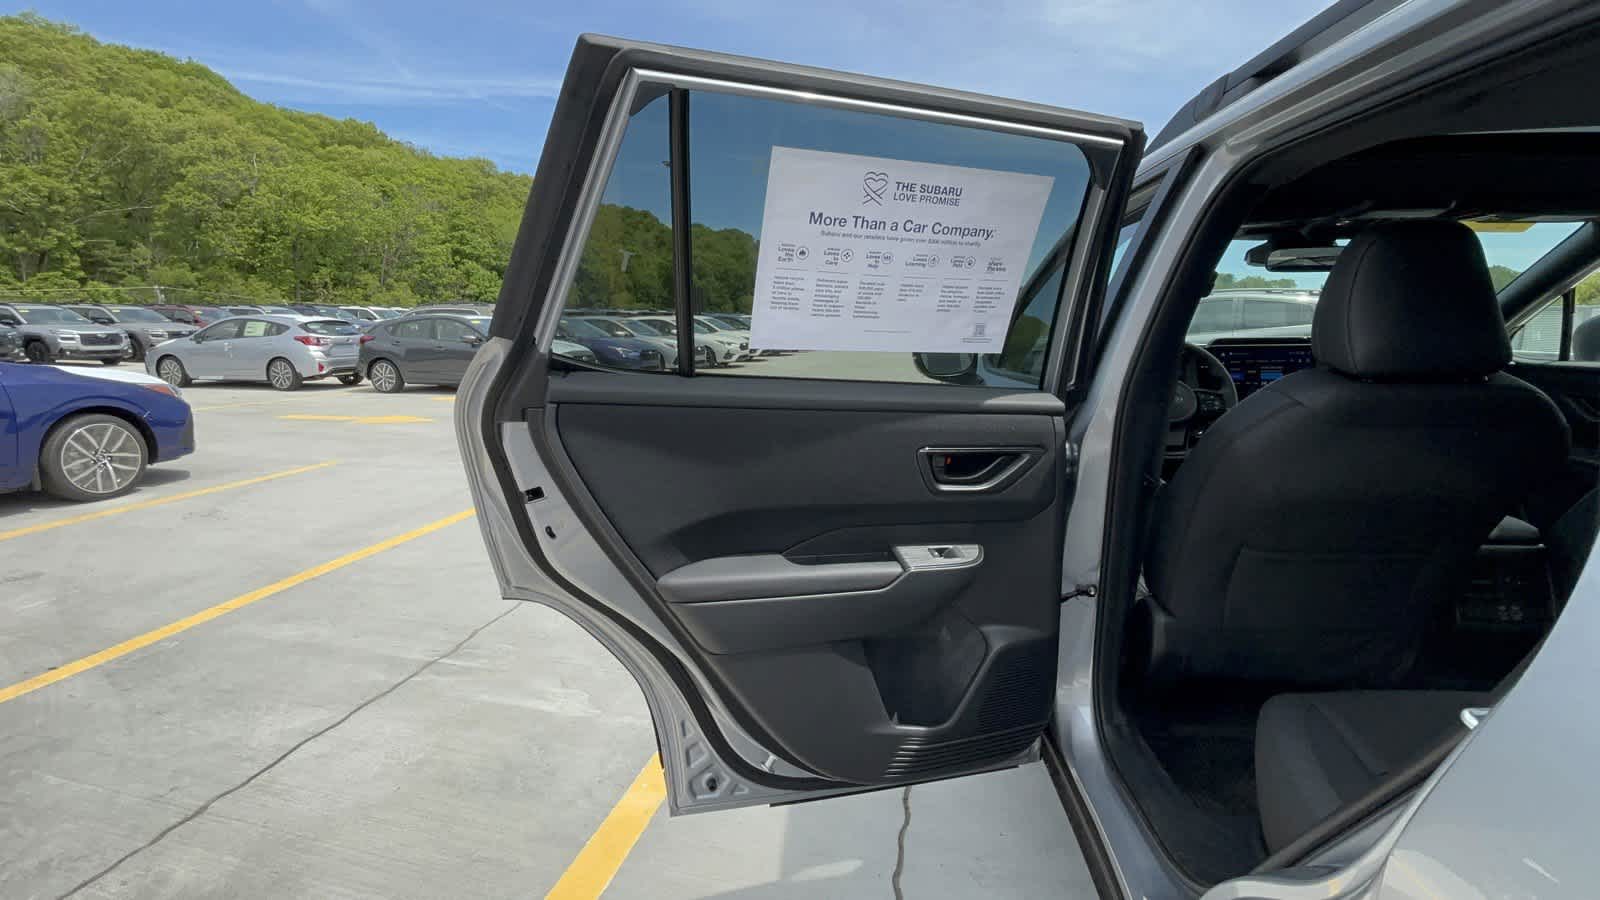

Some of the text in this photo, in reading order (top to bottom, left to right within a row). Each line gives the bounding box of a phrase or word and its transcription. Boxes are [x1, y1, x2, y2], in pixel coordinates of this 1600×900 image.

[895, 181, 963, 197] THE SUBARU
[893, 192, 961, 207] LOVE PROMISE
[808, 211, 848, 228] More
[852, 215, 887, 231] Than
[889, 221, 899, 232] a
[903, 219, 929, 233] Car
